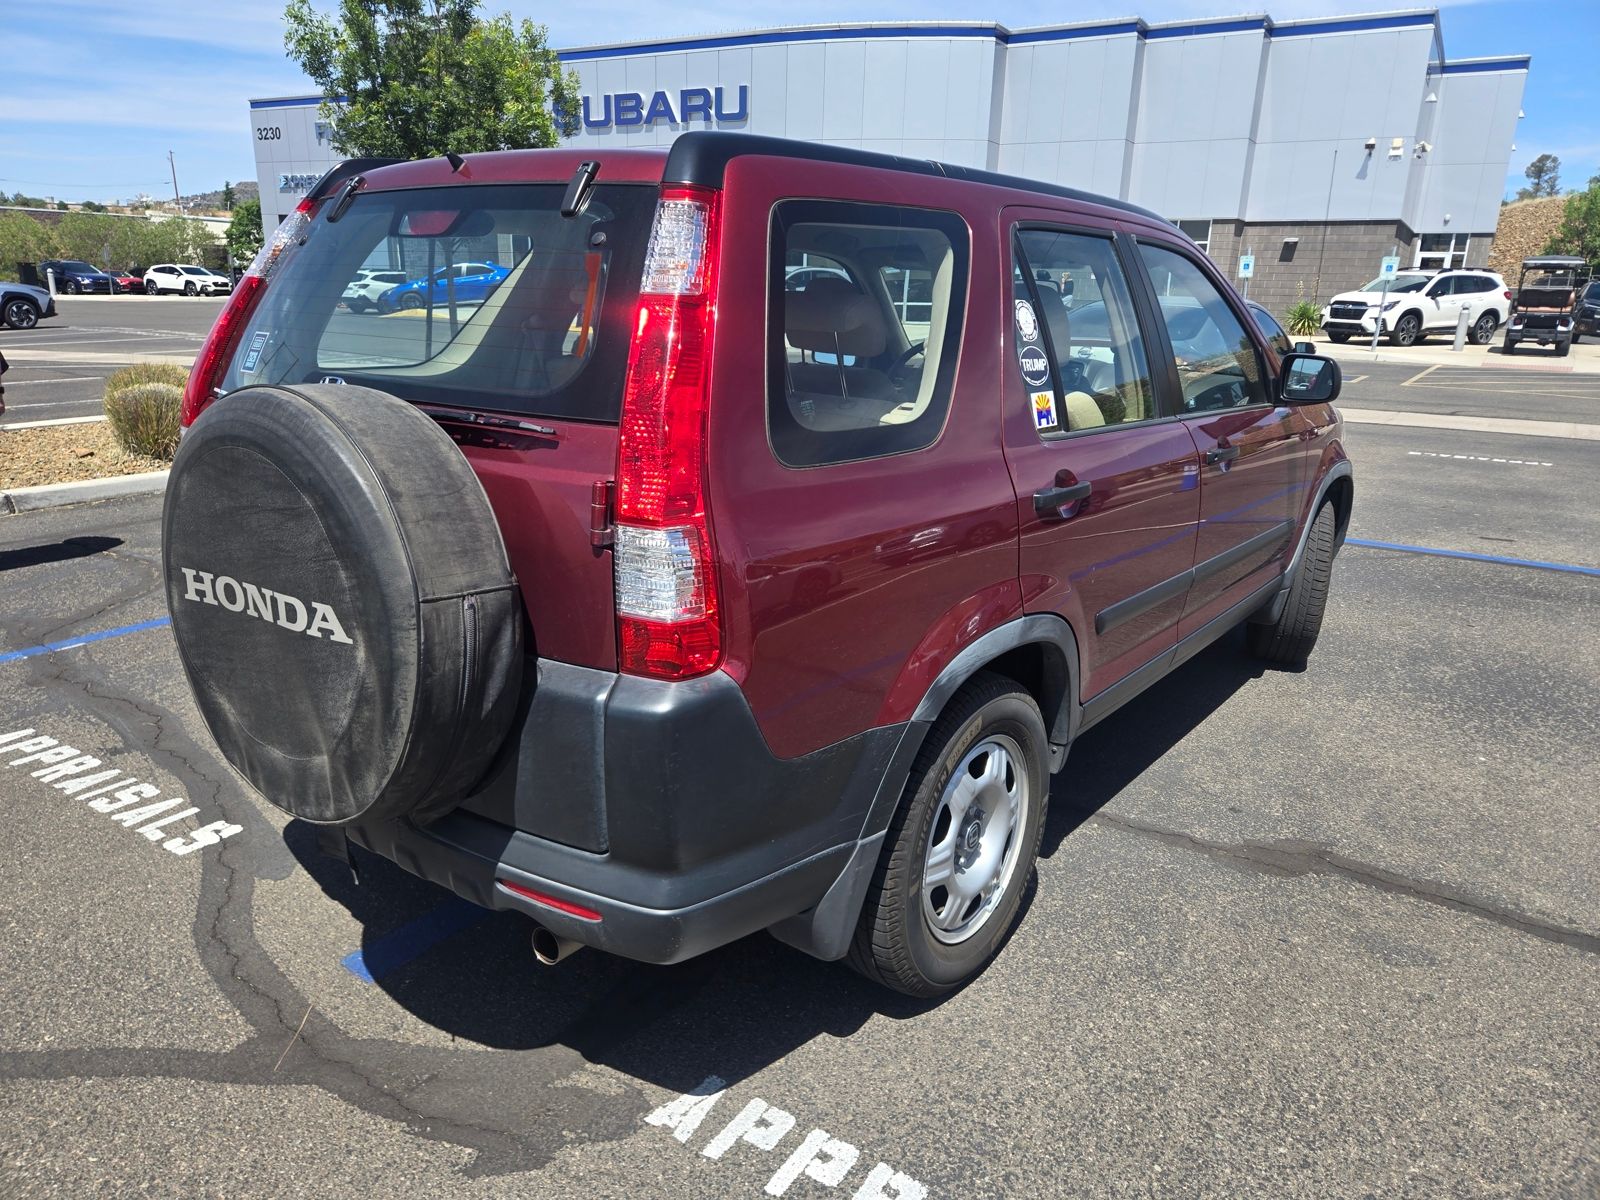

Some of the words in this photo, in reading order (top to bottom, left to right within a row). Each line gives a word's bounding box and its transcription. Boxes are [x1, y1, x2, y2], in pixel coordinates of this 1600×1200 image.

[257, 126, 281, 141] 3230
[1022, 358, 1047, 372] TRUMP
[181, 566, 353, 645] HONDA
